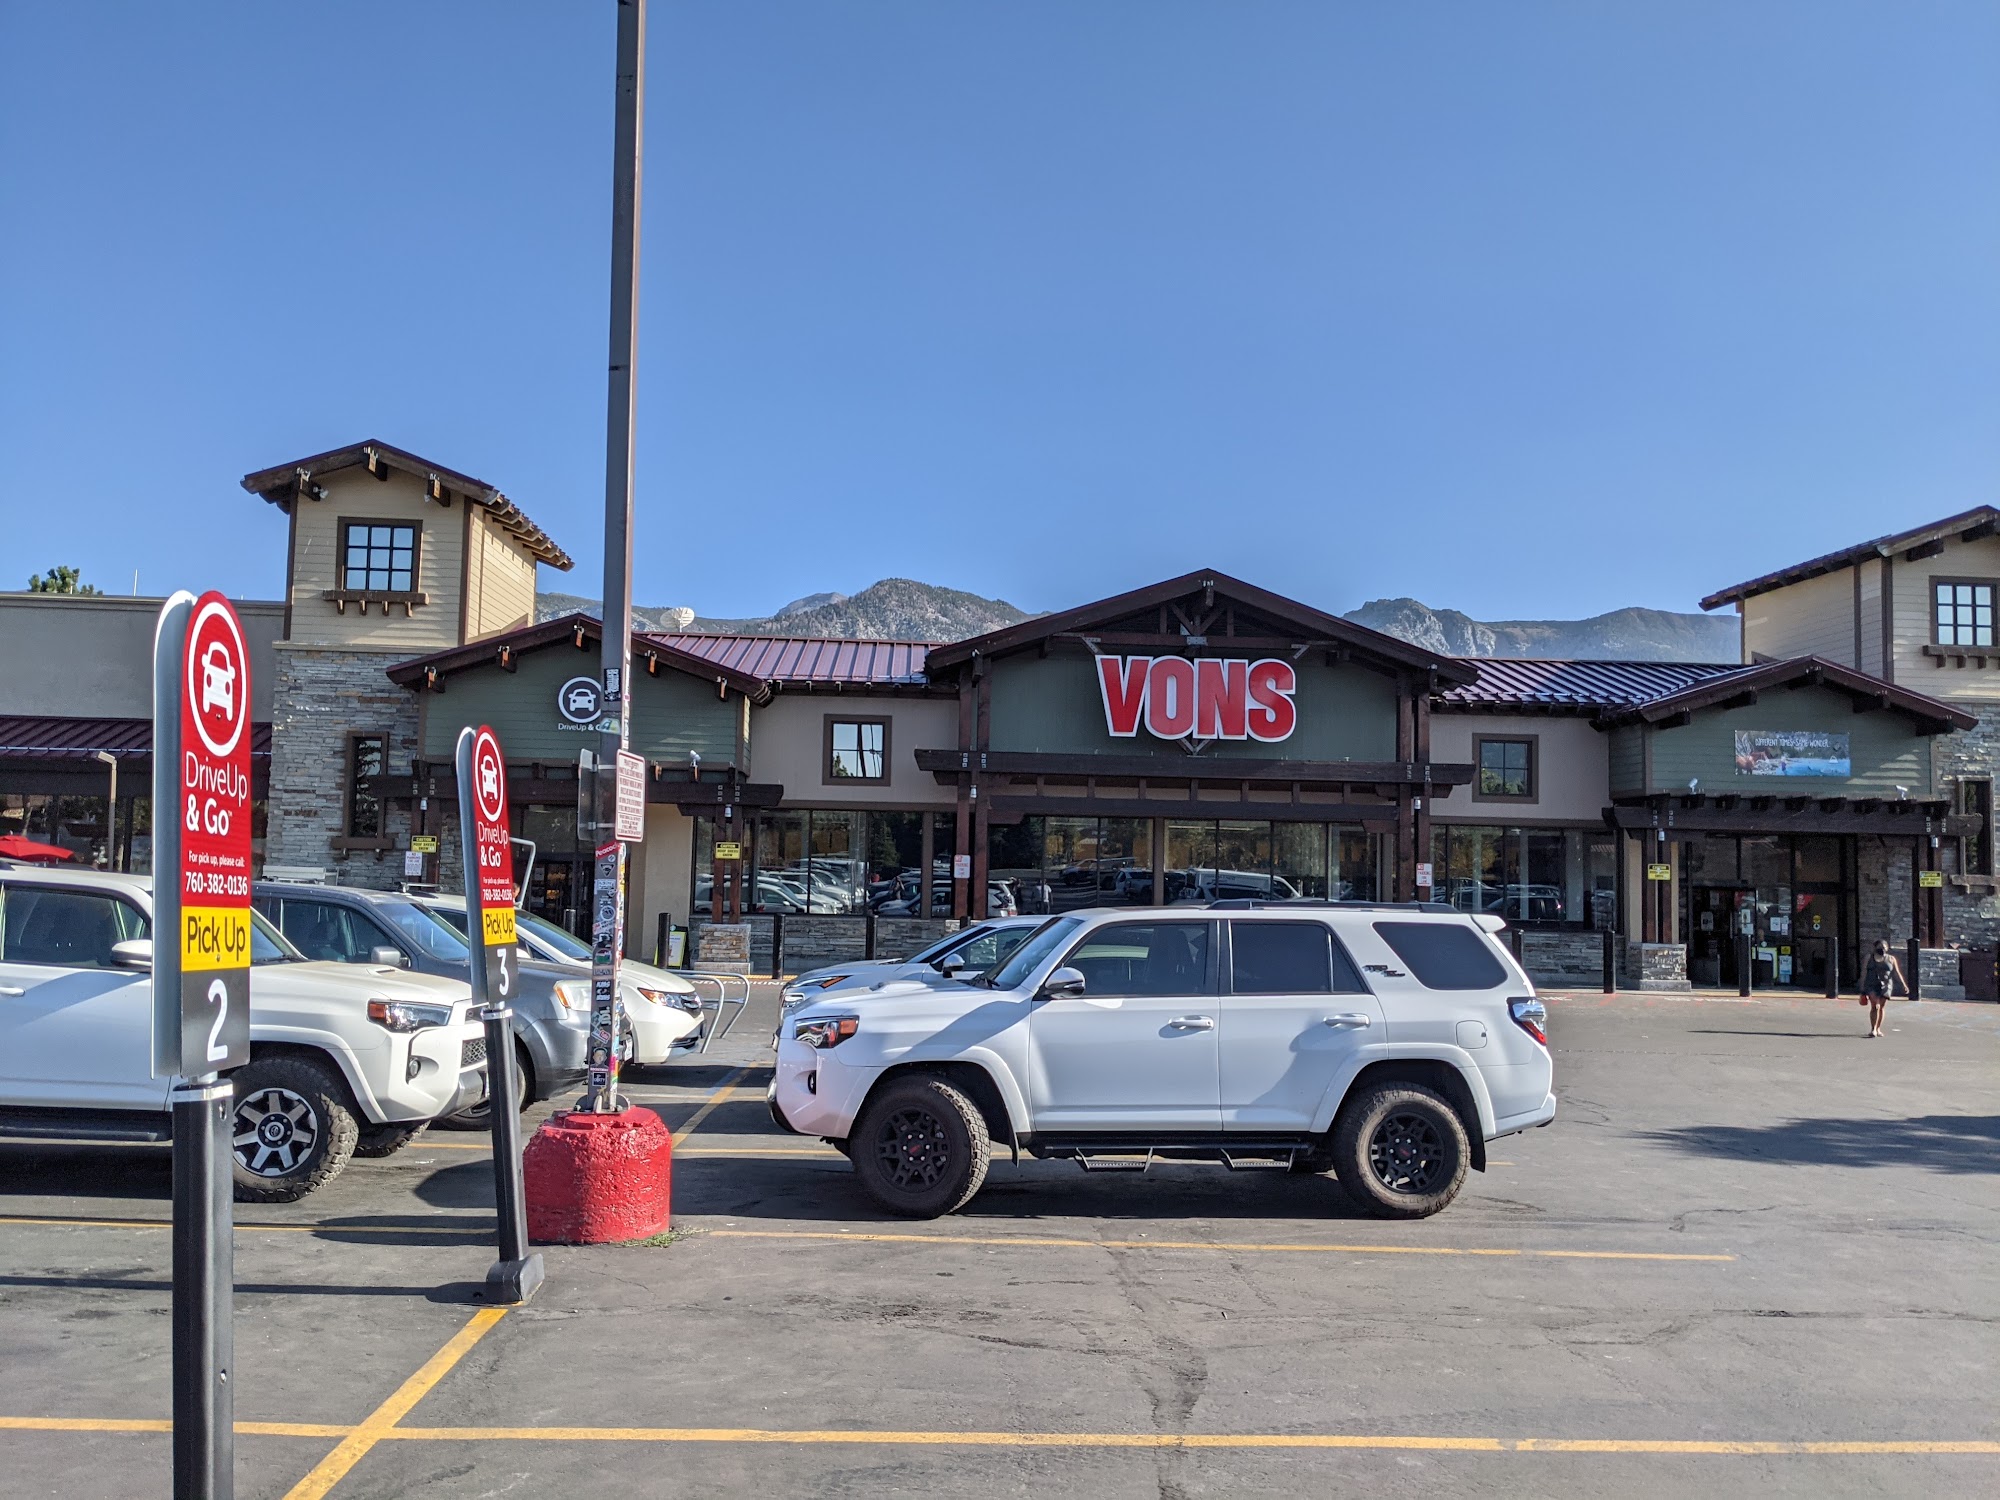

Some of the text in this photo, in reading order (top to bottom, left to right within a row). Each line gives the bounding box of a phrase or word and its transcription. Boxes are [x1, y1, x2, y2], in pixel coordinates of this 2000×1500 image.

[1095, 655, 1296, 742] VONS
[558, 723, 586, 731] DriveUp
[1755, 738, 1778, 746] DIFFERENT
[186, 751, 247, 807] DriveUp
[186, 794, 200, 831] &
[478, 821, 508, 849] DriveUp
[188, 850, 245, 867] For pick up, please call:
[480, 845, 488, 867] &
[185, 871, 248, 895] 760-382-0136
[187, 916, 246, 962] Pick Up
[486, 912, 513, 939] Pick Up
[497, 948, 509, 996] 3
[207, 979, 228, 1062] 2
